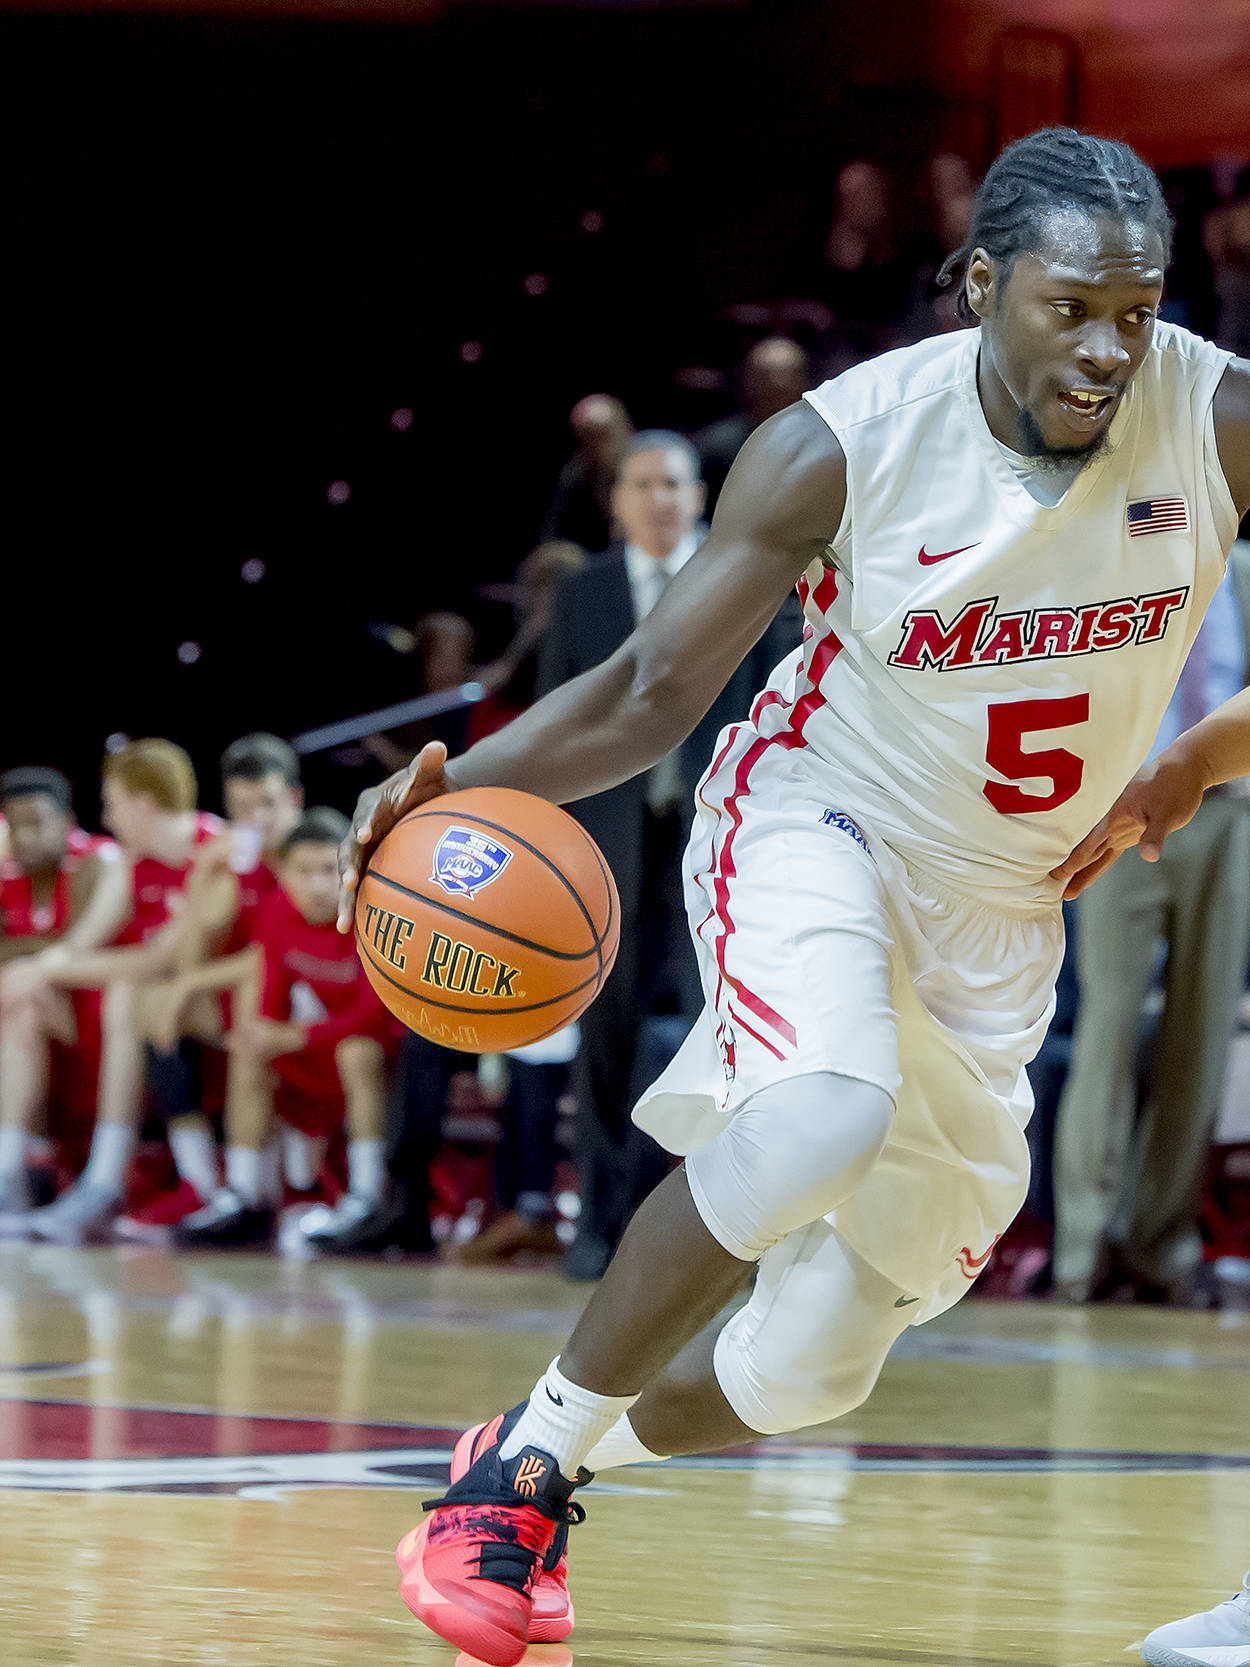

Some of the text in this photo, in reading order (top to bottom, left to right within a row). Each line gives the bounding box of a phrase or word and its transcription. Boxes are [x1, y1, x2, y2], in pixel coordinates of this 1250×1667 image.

[887, 586, 1190, 672] MARIST
[981, 693, 1090, 814] 5
[365, 903, 522, 998] THE ROCK
